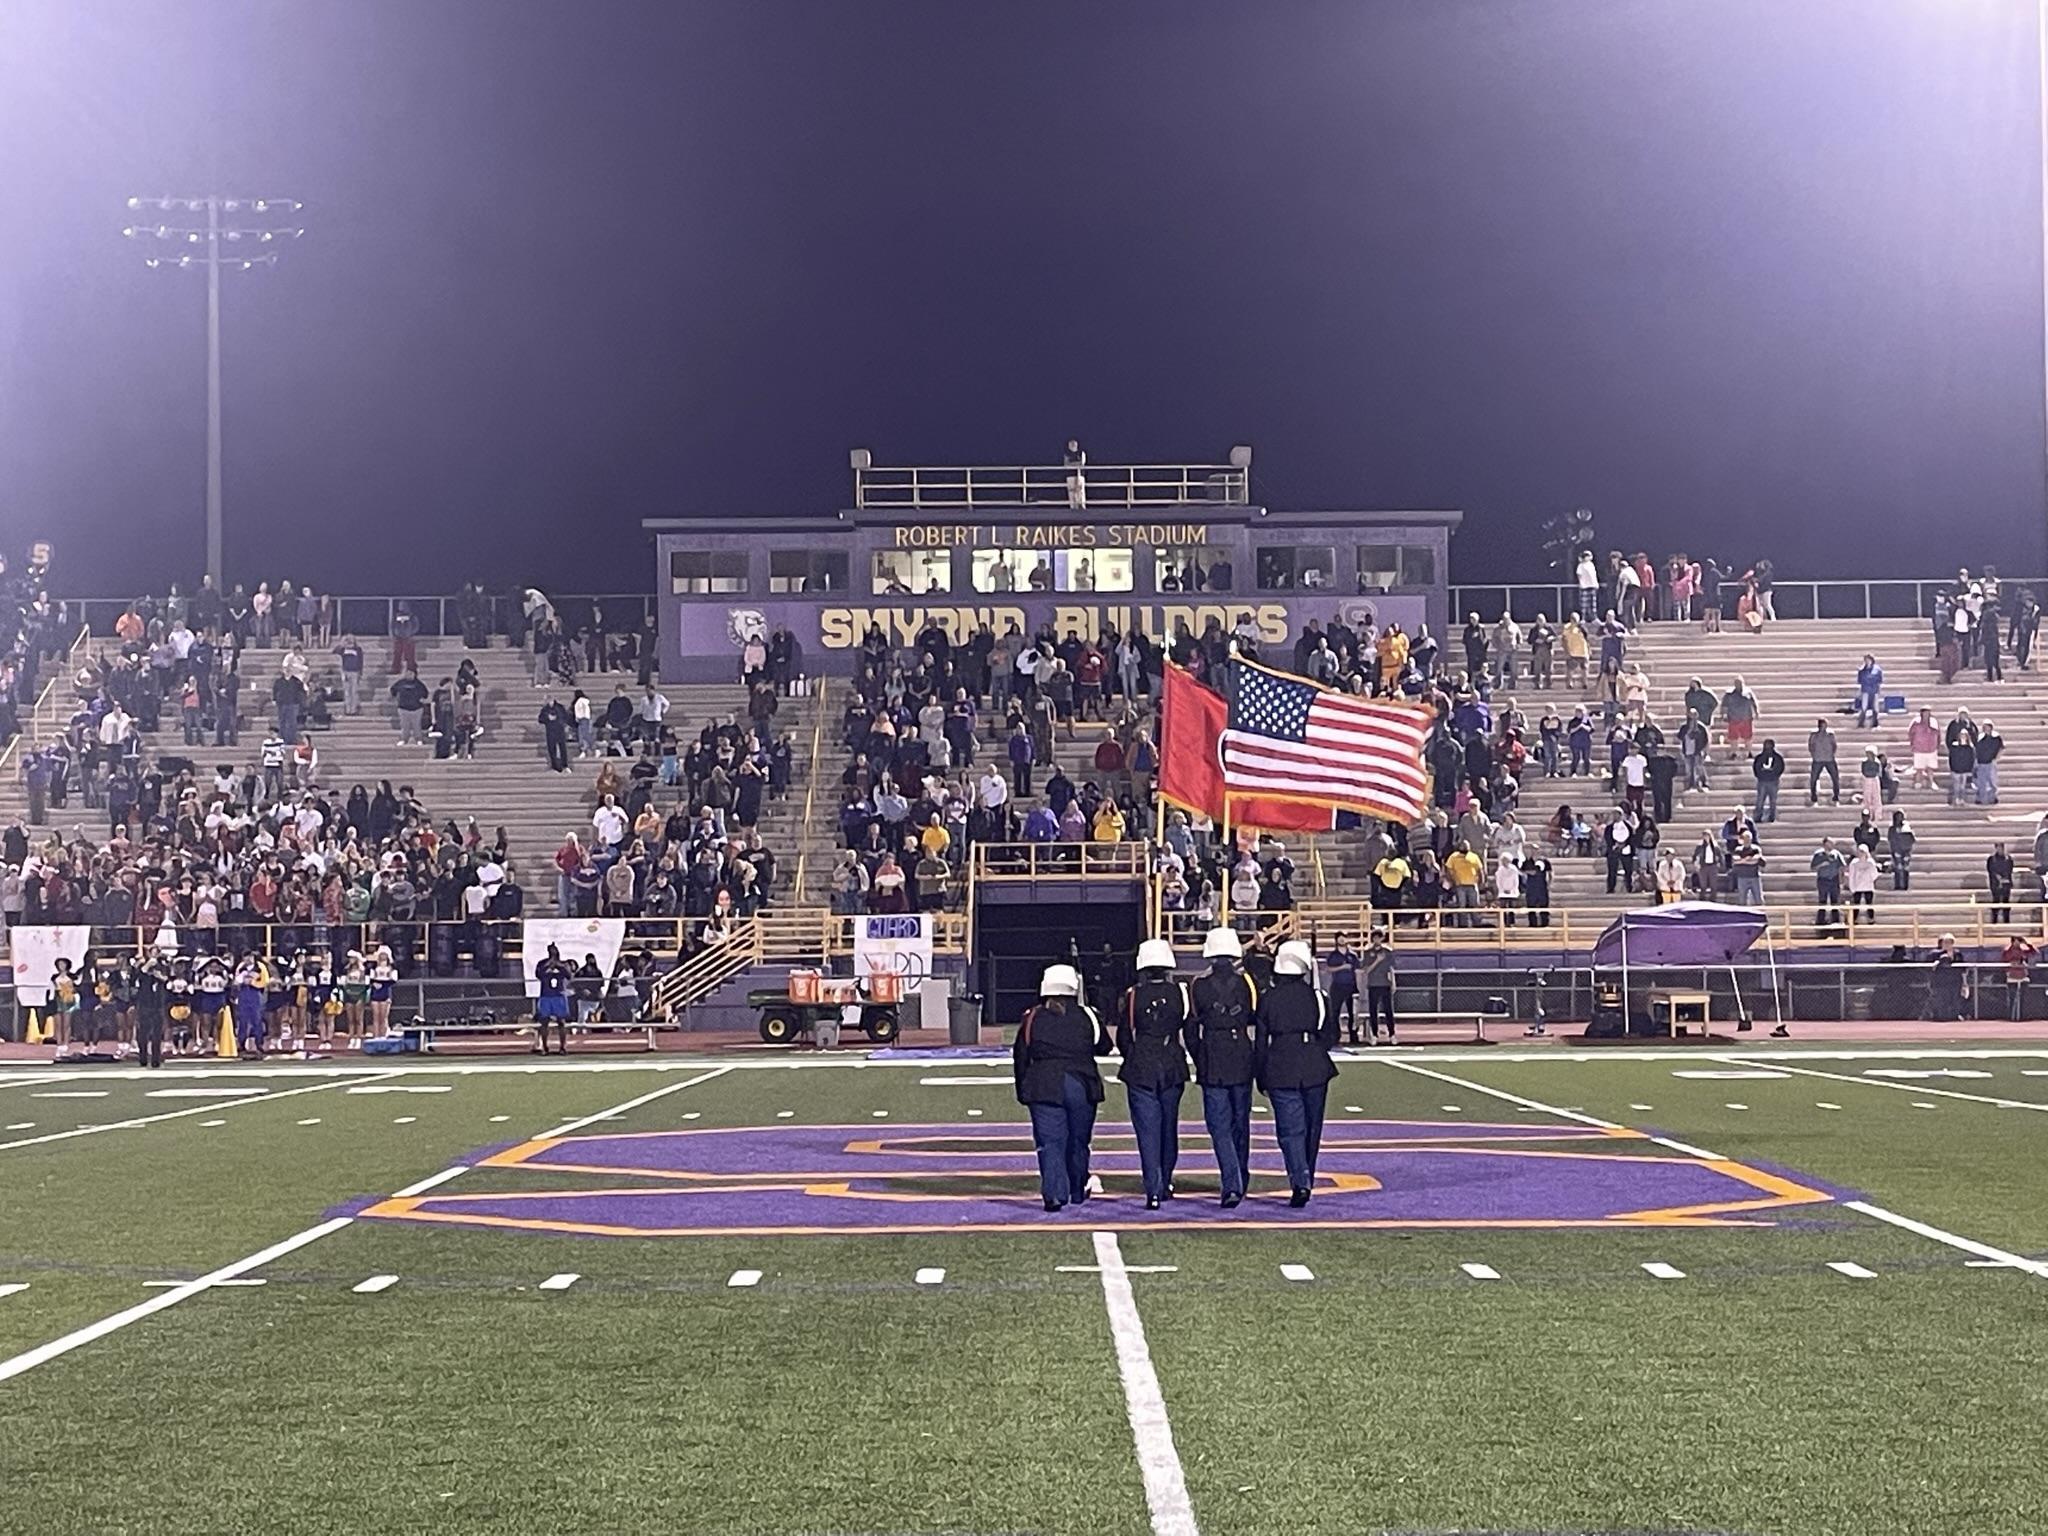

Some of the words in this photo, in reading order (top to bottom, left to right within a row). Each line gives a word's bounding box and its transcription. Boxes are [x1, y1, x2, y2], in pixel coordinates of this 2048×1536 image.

[896, 525, 983, 547] ROBERT
[992, 525, 1002, 546] L
[1016, 525, 1097, 546] RAIKES
[1108, 524, 1207, 546] STADIUM
[820, 606, 1026, 649] SMYRNA
